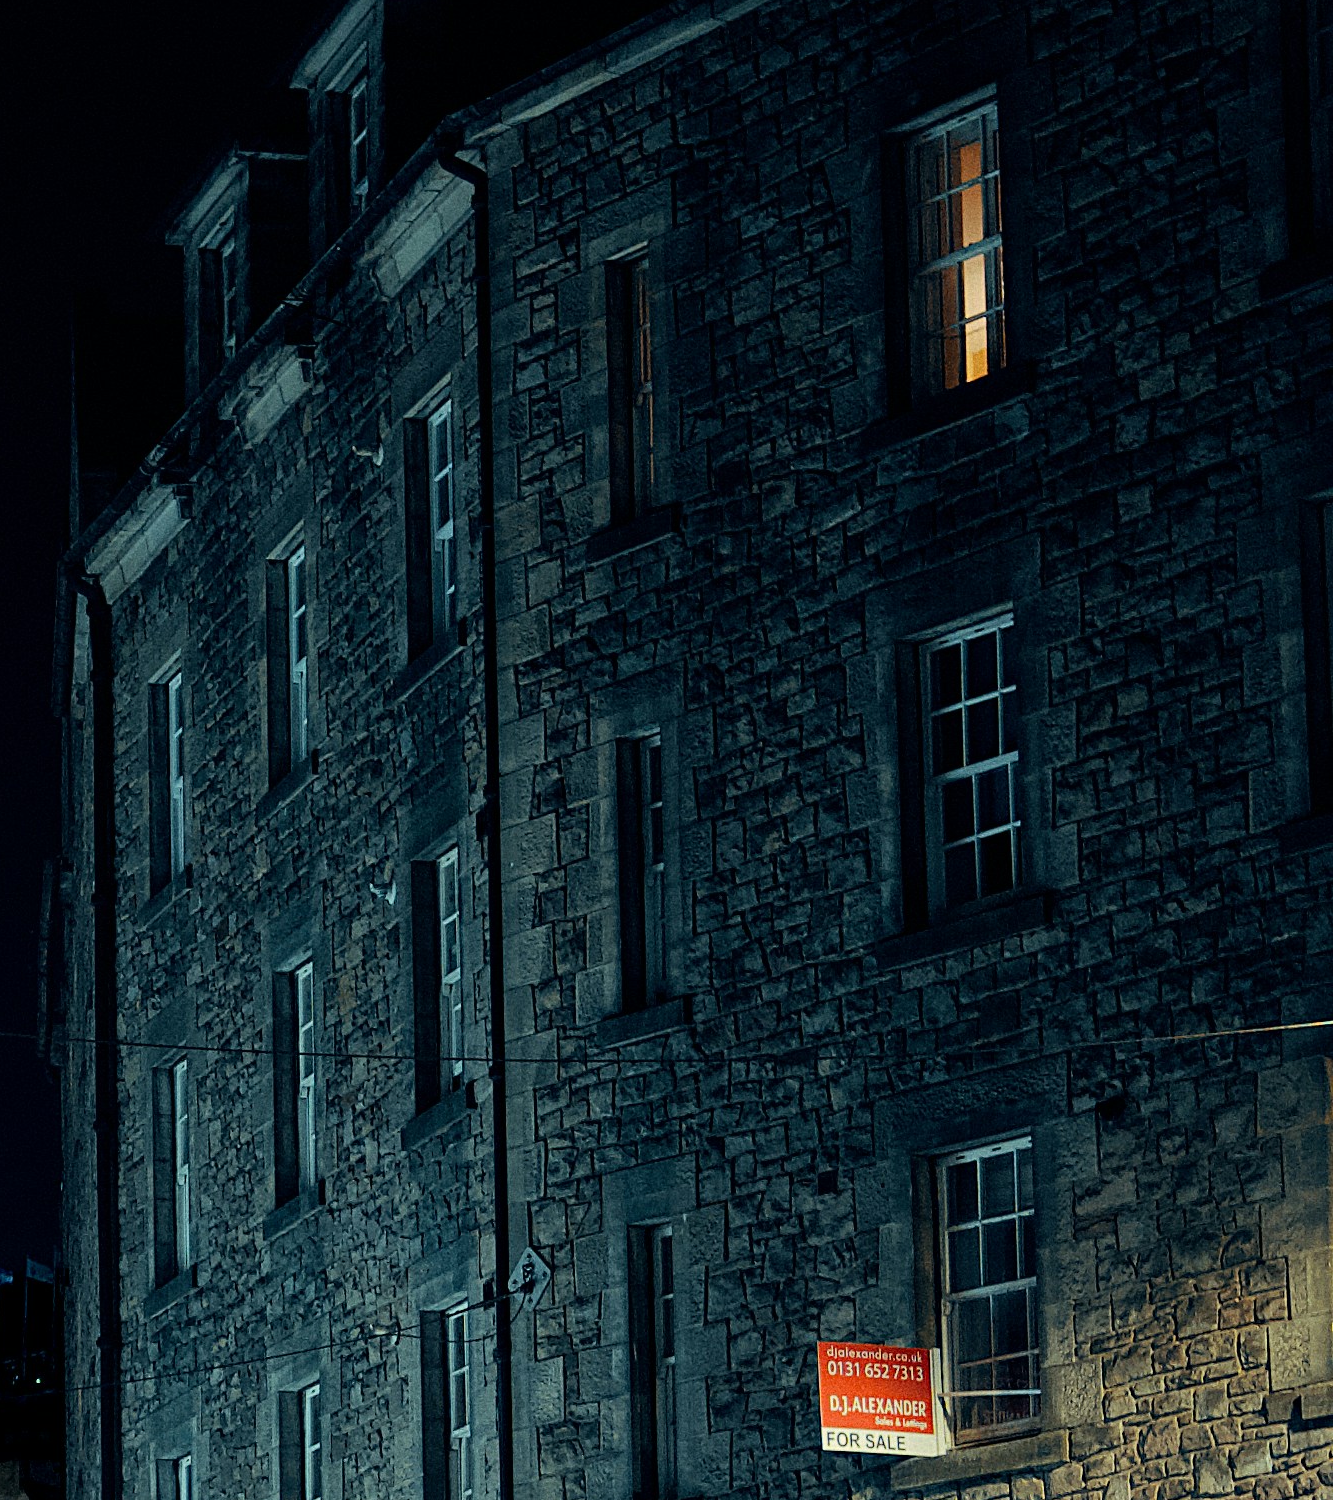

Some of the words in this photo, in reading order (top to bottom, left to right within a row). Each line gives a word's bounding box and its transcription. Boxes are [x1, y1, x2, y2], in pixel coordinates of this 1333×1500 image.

[827, 1345, 923, 1363] djalexander.co.uk
[827, 1360, 860, 1377] 0131
[864, 1363, 889, 1379] 652
[892, 1365, 923, 1382] 7313
[827, 1431, 860, 1448] FOR
[865, 1434, 906, 1451] SALE
